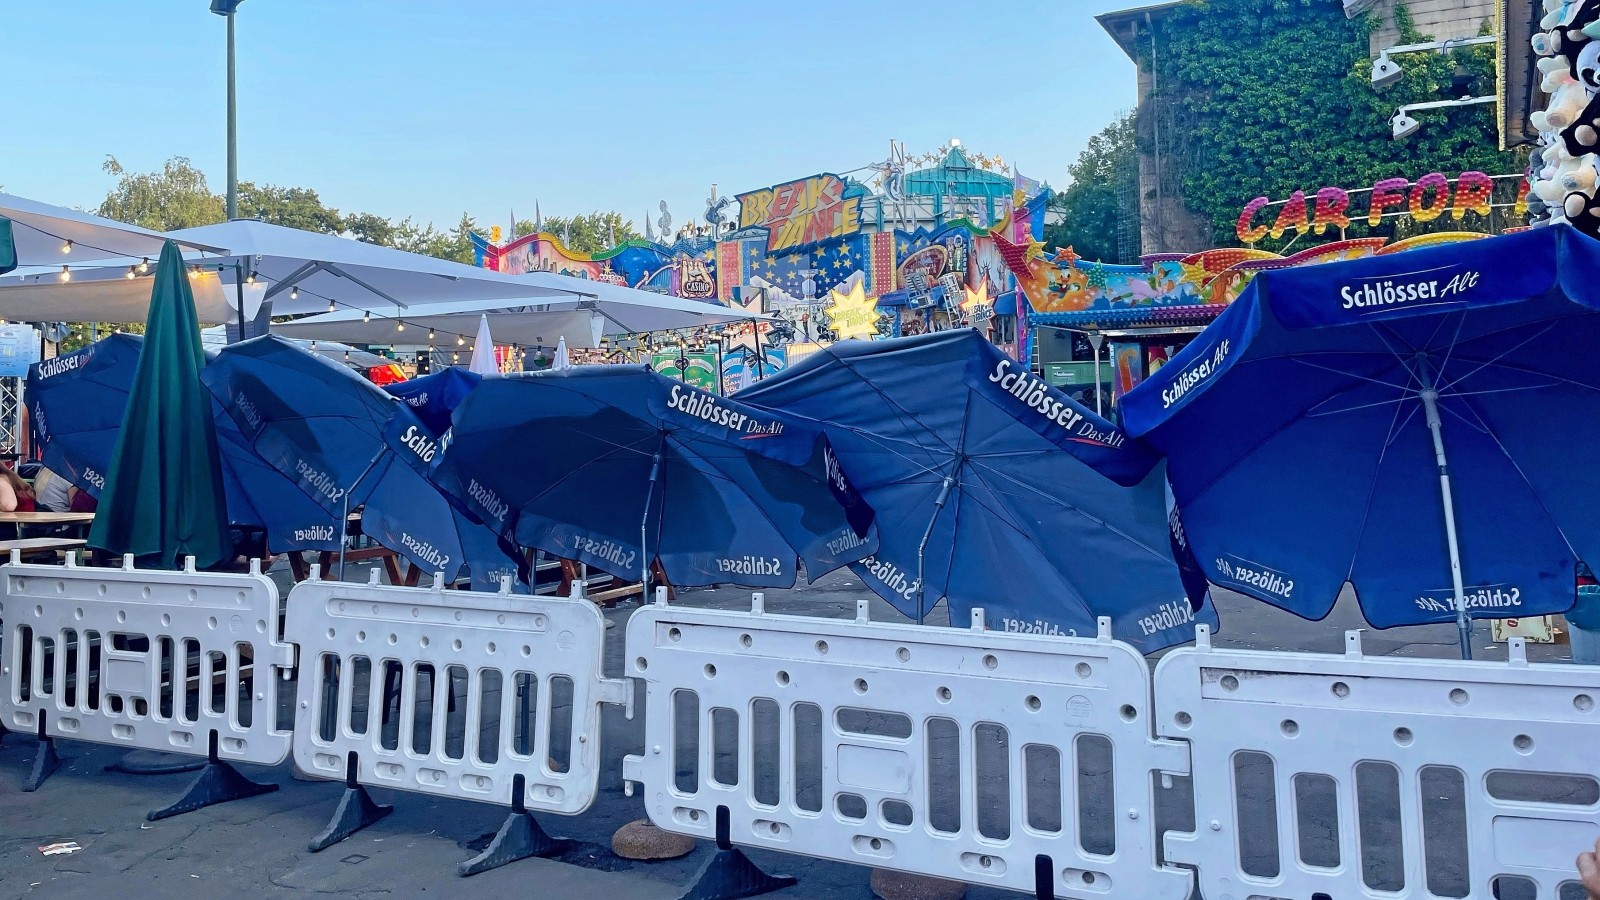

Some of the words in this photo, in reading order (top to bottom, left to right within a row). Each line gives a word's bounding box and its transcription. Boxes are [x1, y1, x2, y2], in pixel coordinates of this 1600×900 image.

[740, 175, 845, 227] BREAK
[1236, 186, 1350, 243] CAR
[1367, 171, 1494, 227] FOR
[686, 281, 710, 292] CASINO
[1340, 280, 1438, 309] Schlösser
[1440, 271, 1480, 298] Alt
[38, 355, 79, 380] Schlösser
[1162, 359, 1211, 409] Schlösser
[1211, 339, 1230, 372] Alt
[667, 384, 748, 431] Schlösser
[988, 359, 1084, 430] Schlösser
[400, 425, 438, 462] Schlö
